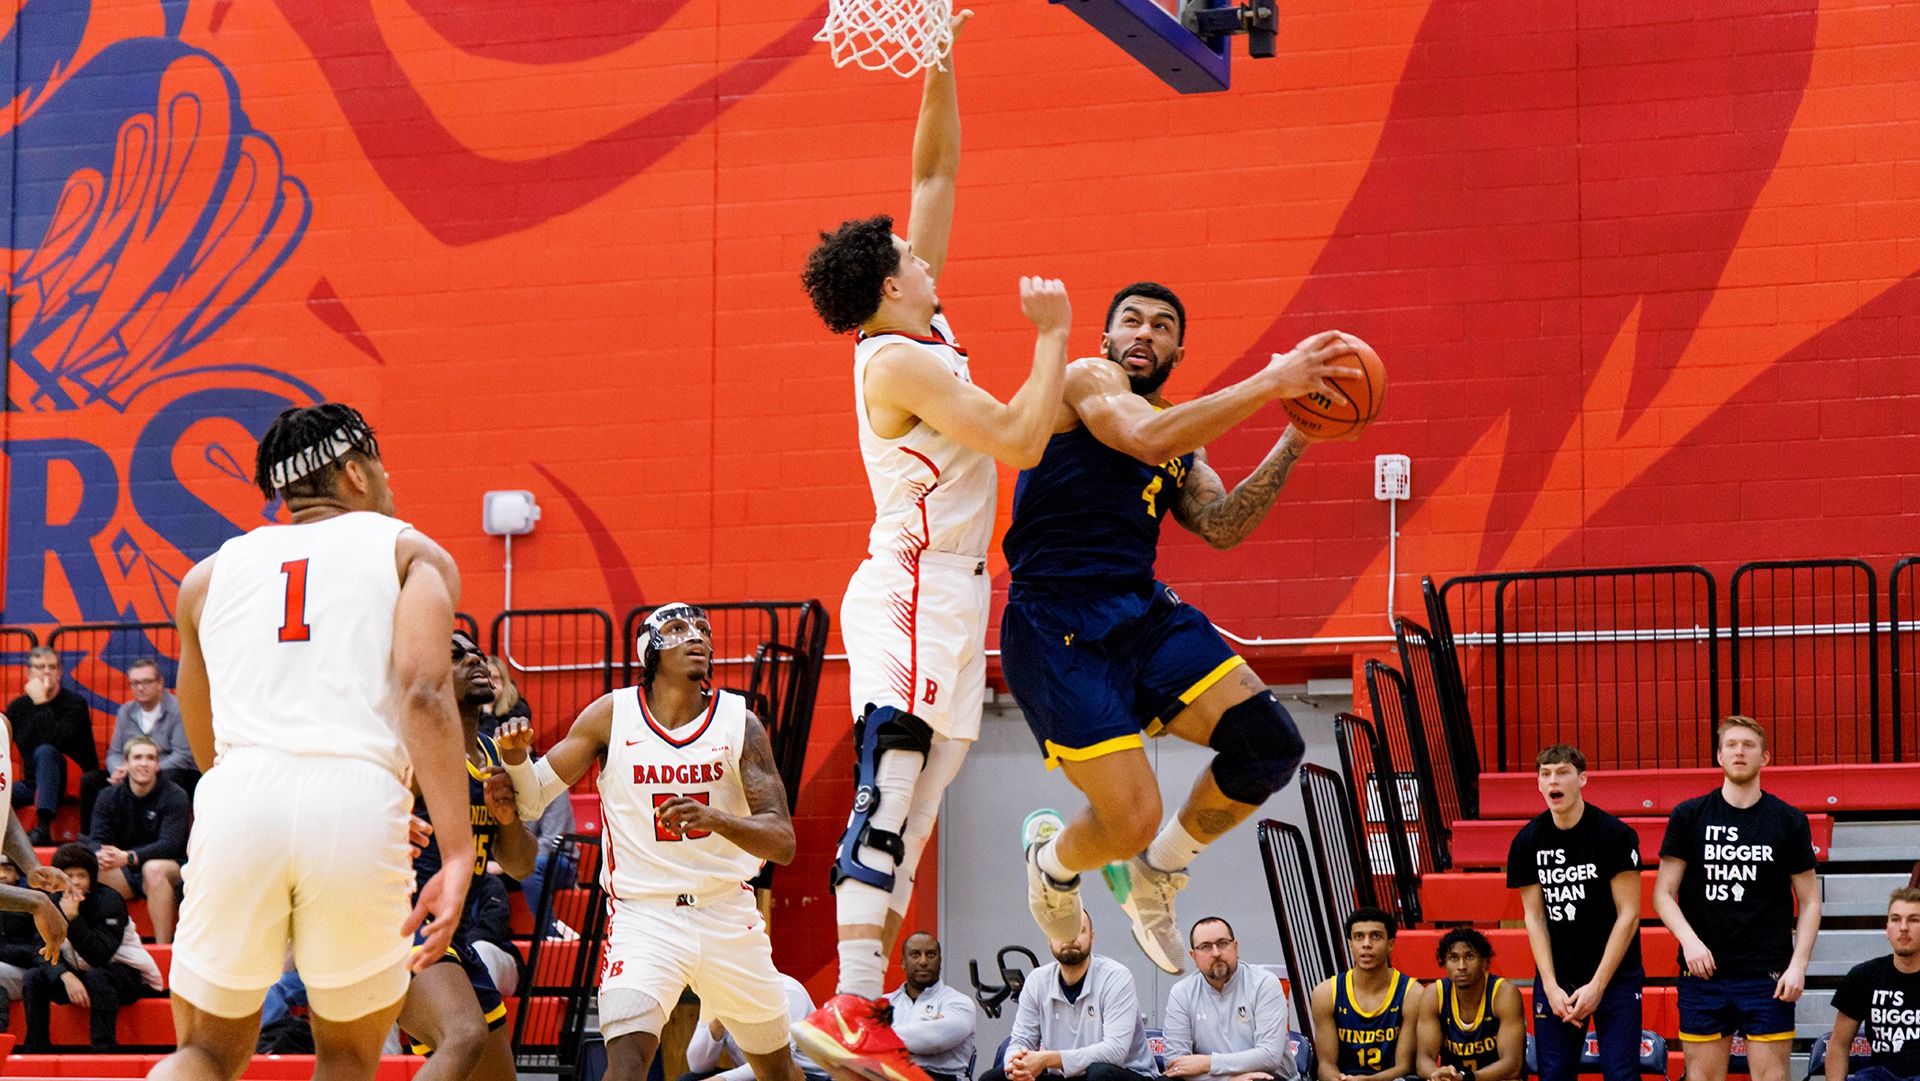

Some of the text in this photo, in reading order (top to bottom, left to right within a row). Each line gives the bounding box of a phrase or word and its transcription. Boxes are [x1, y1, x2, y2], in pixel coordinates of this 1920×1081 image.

[1141, 475, 1163, 518] 4
[278, 557, 311, 643] 1
[921, 677, 938, 705] B
[633, 761, 724, 784] BADGERS
[1705, 825, 1739, 842] IT'S
[1536, 848, 1566, 866] IT'S
[1704, 844, 1774, 862] BIGGER
[1538, 863, 1599, 885] BIGGER
[1704, 864, 1757, 881] THAN
[1705, 884, 1729, 901] US
[608, 960, 624, 979] B
[1871, 989, 1905, 1007] IT'S
[1871, 1039, 1890, 1053] US
[1356, 1047, 1382, 1070] 12
